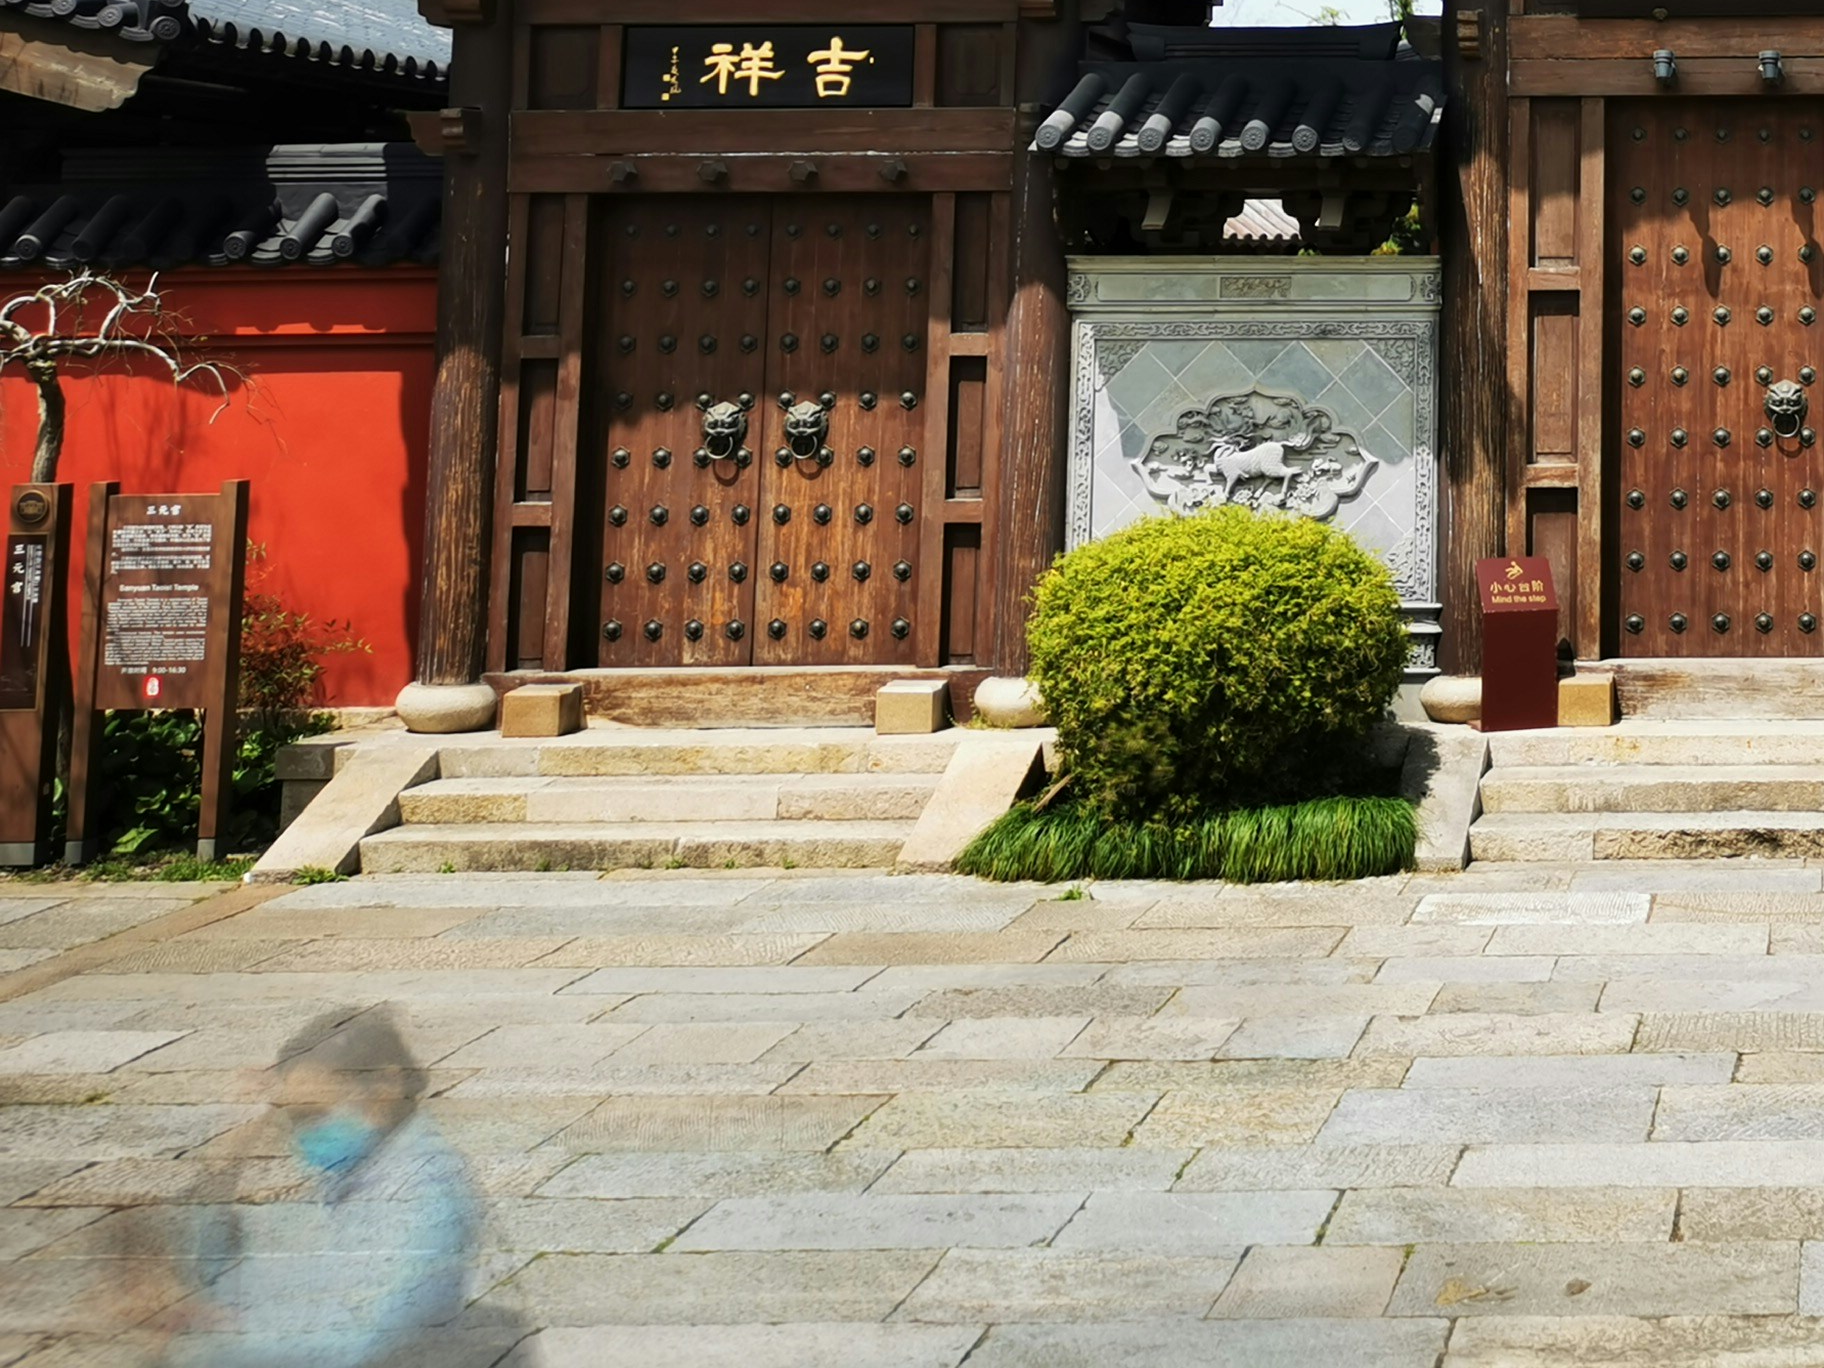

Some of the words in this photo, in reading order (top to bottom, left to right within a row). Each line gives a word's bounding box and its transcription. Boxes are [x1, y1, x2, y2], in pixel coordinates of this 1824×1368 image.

[700, 36, 871, 97] 吉祥
[1490, 579, 1544, 594] 小心台阶
[1491, 595, 1512, 603] Mind
[1513, 595, 1527, 603] the
[1528, 594, 1546, 603] step
